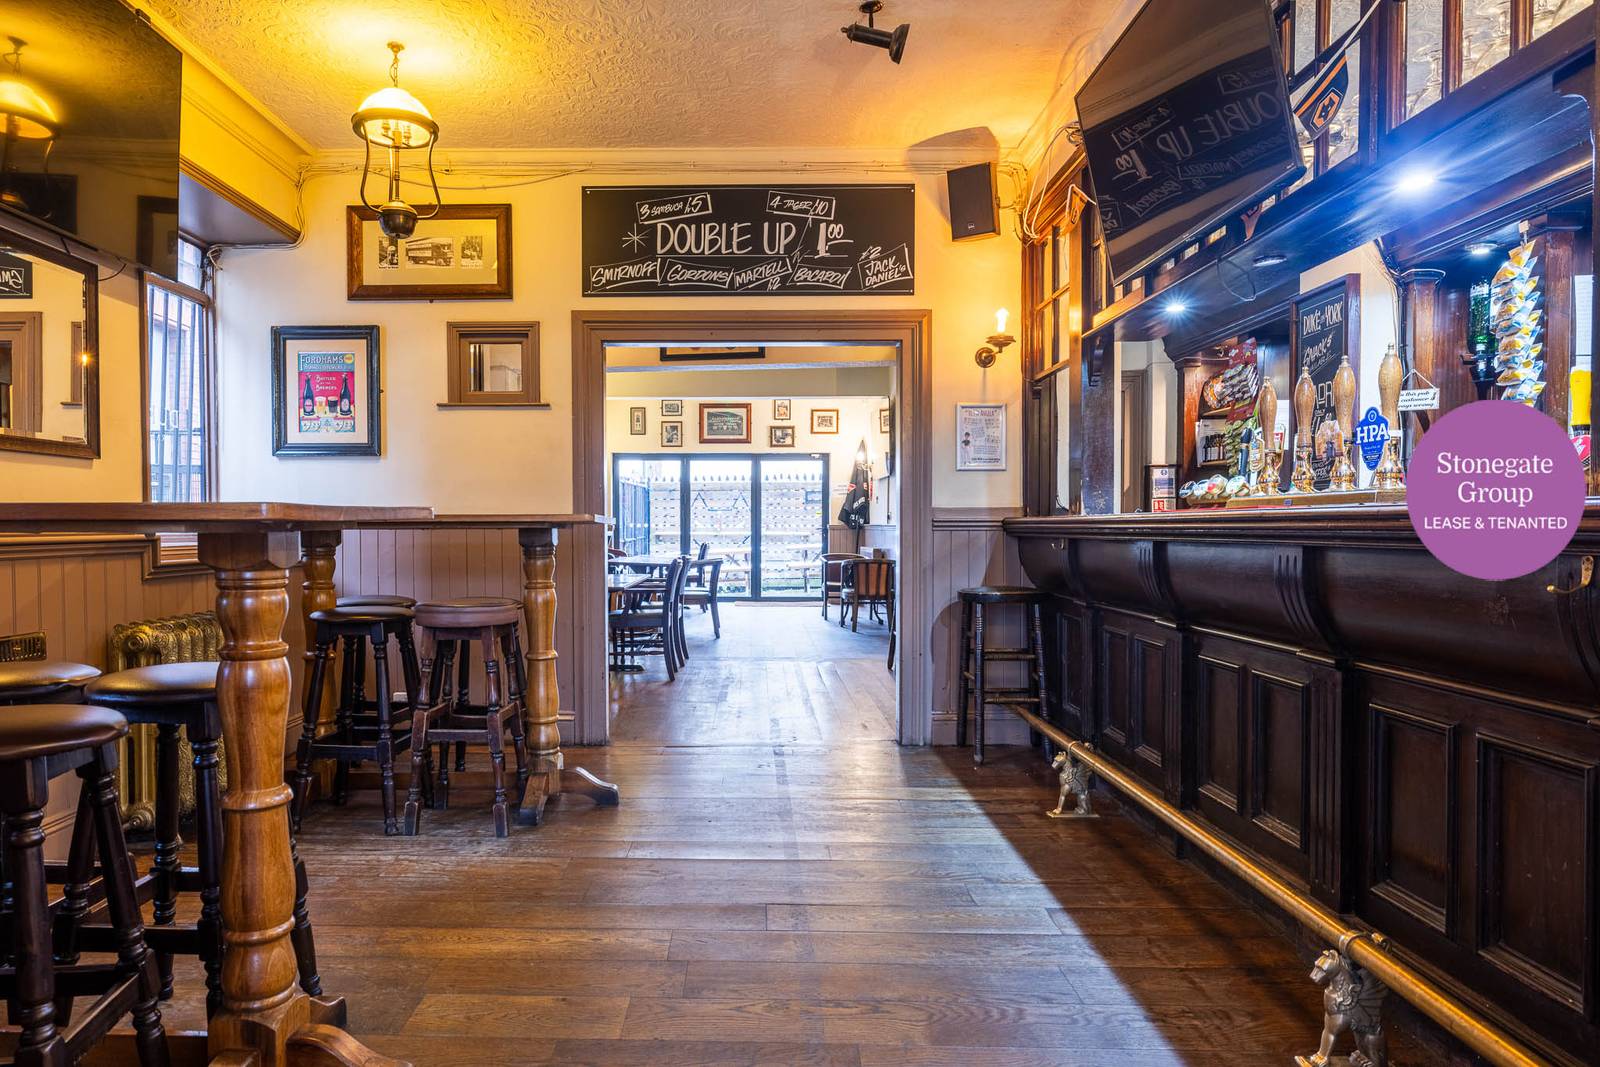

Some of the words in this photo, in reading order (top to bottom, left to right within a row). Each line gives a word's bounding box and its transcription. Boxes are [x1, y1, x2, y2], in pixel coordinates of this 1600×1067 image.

[639, 204, 650, 219] 3
[769, 195, 782, 209] 4
[656, 222, 752, 255] DOUBLE
[763, 221, 796, 255] UP
[592, 261, 658, 287] SMIRNOFF
[667, 264, 729, 282] GORDONS
[736, 260, 786, 287] MARTELL
[864, 255, 900, 275] JACK
[794, 267, 847, 284] BACARDI
[1303, 309, 1321, 335] DUKE
[1324, 301, 1343, 327] YORK
[1355, 423, 1390, 444] HPA
